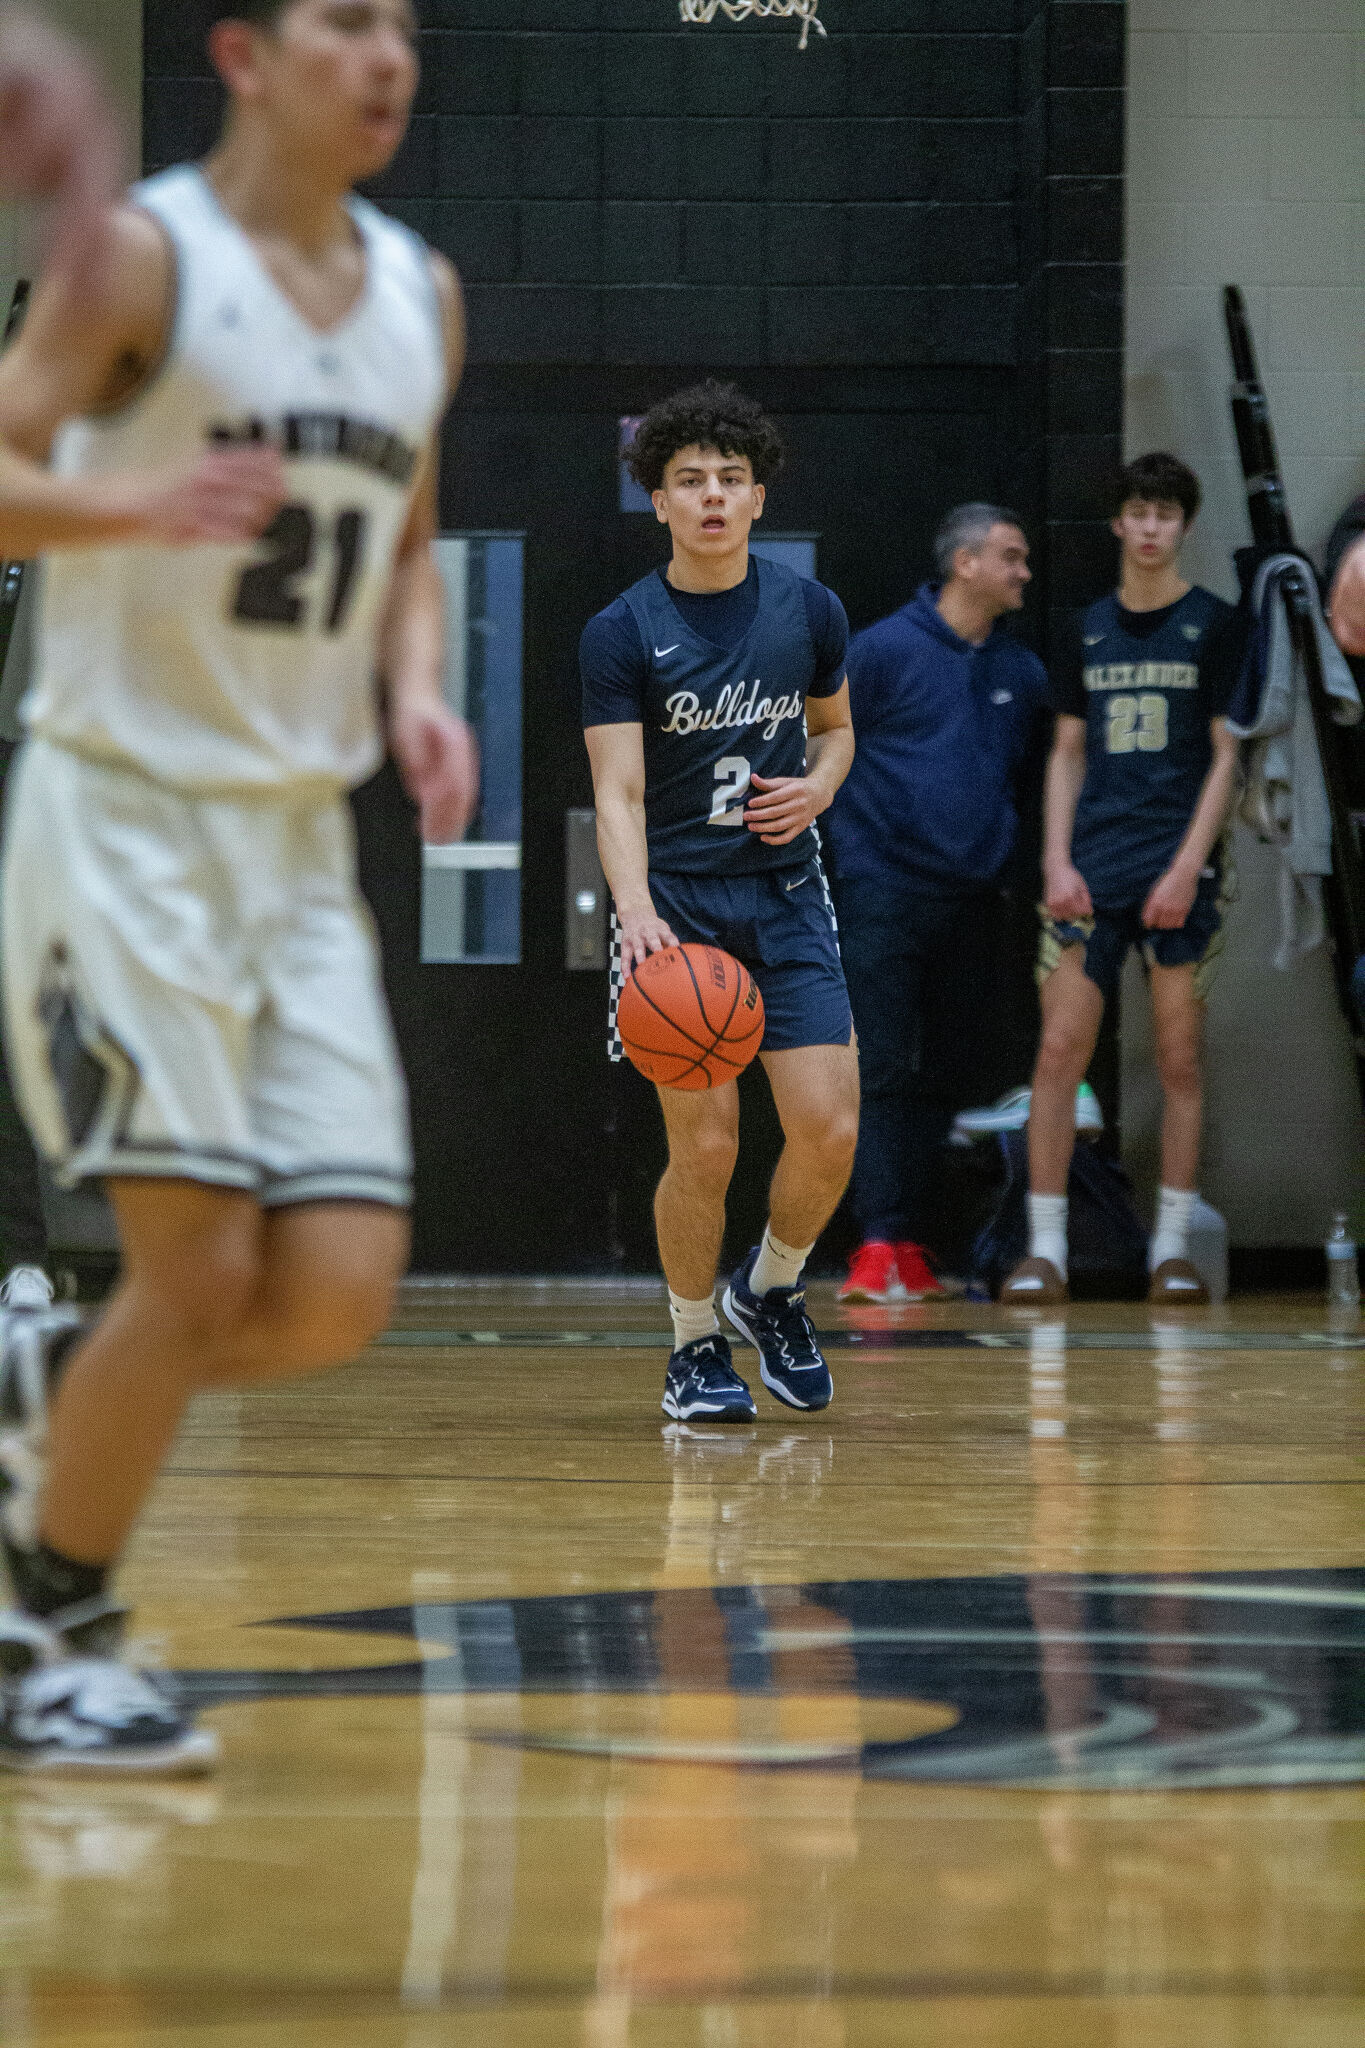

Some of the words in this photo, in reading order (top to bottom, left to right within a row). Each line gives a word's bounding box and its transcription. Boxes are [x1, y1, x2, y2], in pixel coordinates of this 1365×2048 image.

[234, 501, 366, 629] 21
[661, 679, 803, 741] Bulldogs
[1107, 694, 1168, 754] 23
[706, 756, 750, 826] 2
